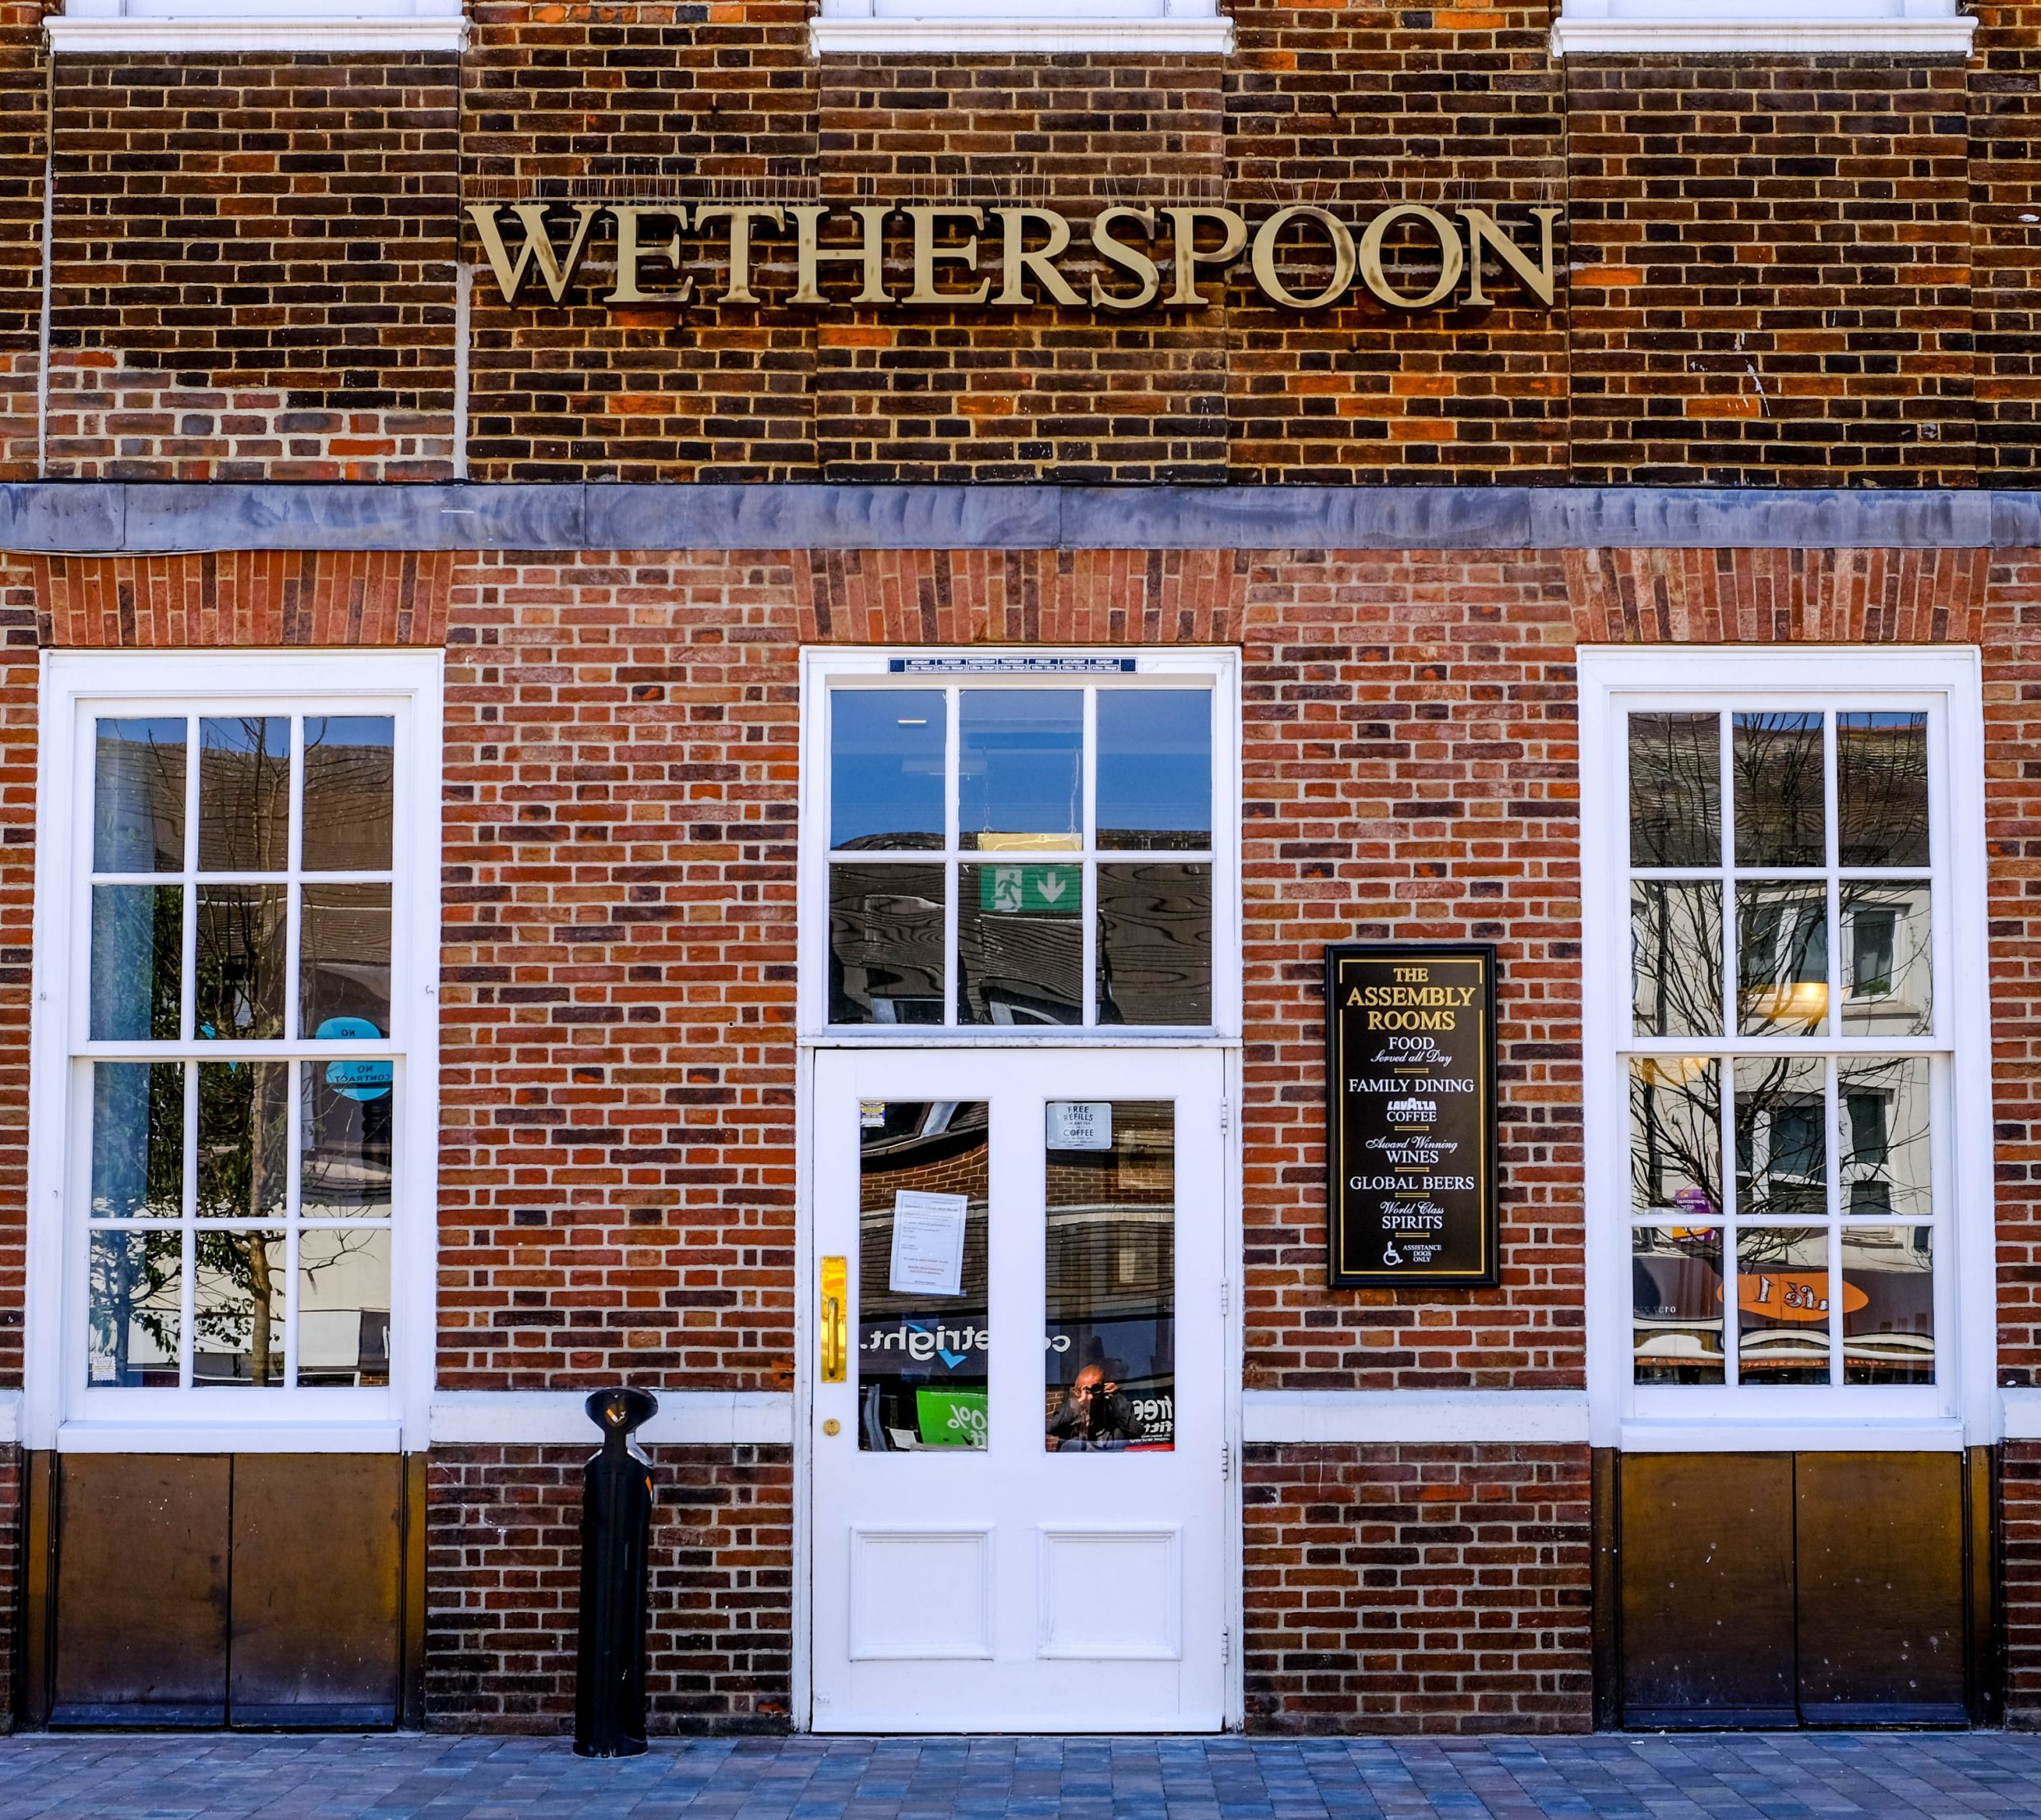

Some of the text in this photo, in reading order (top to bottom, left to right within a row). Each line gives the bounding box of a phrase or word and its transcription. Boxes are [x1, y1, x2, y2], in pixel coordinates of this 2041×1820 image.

[464, 205, 1563, 308] WETHERSPOON
[1393, 968, 1429, 982] THE
[1346, 986, 1476, 1006] ASSEMBLY
[1367, 1010, 1456, 1031] ROOMS
[1388, 1037, 1435, 1051] FOOD
[1370, 1049, 1453, 1067] Served all Day
[1348, 1079, 1475, 1092] FAMILY DINING
[1387, 1097, 1438, 1111] LAVAZZA
[1064, 1113, 1094, 1121] REFILLS
[1386, 1111, 1438, 1122] COFFEE
[1365, 1135, 1459, 1153] Award Winning
[1386, 1151, 1439, 1164] WINES
[1350, 1176, 1475, 1190] GLOBAL BEERS
[1379, 1201, 1444, 1214] World Class
[1382, 1216, 1443, 1230] SPIRITS
